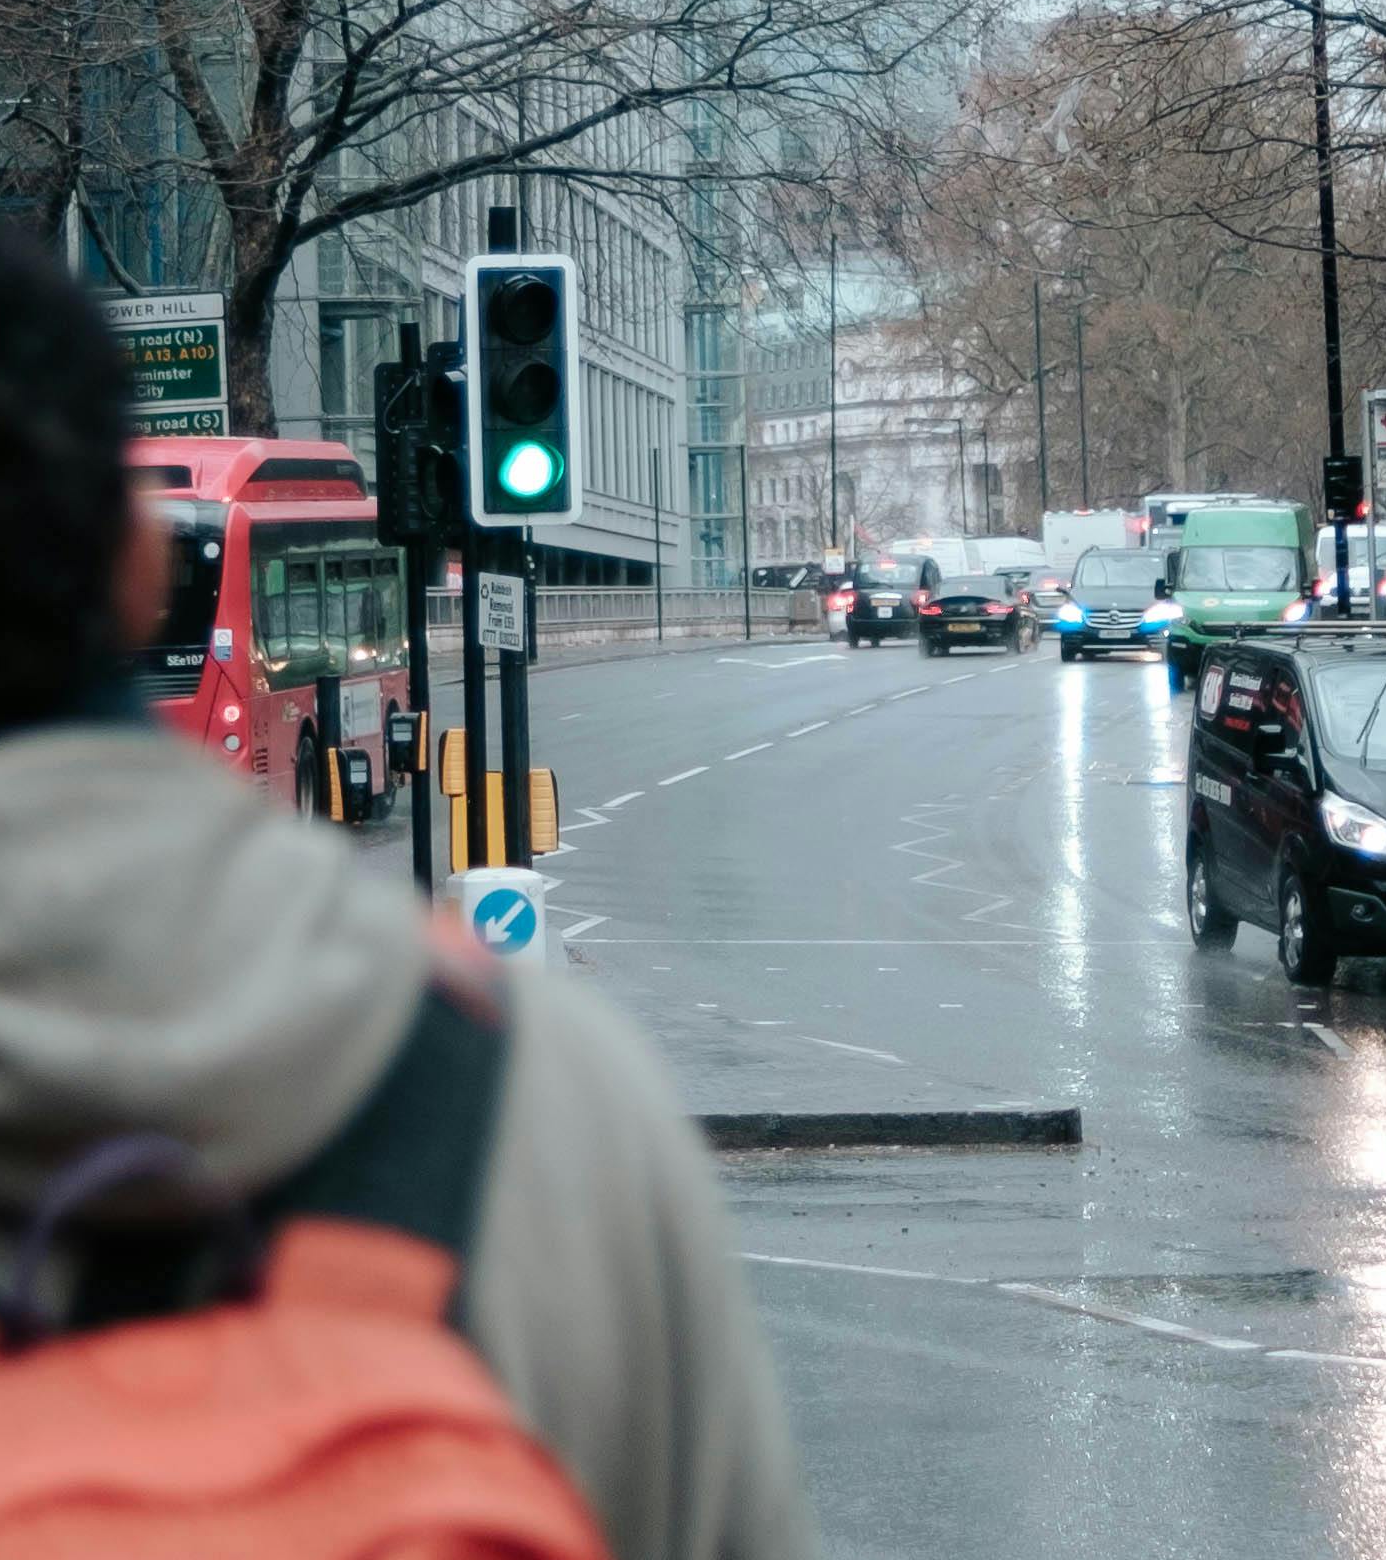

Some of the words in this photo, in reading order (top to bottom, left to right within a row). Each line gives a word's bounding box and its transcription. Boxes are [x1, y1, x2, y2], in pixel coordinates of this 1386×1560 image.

[108, 303, 155, 319] OWER
[163, 301, 197, 315] HILL
[141, 332, 172, 346] road
[175, 329, 204, 346] (N)
[179, 344, 215, 360] A10)
[137, 385, 164, 398] City
[156, 416, 188, 430] road
[193, 413, 220, 429] (S)
